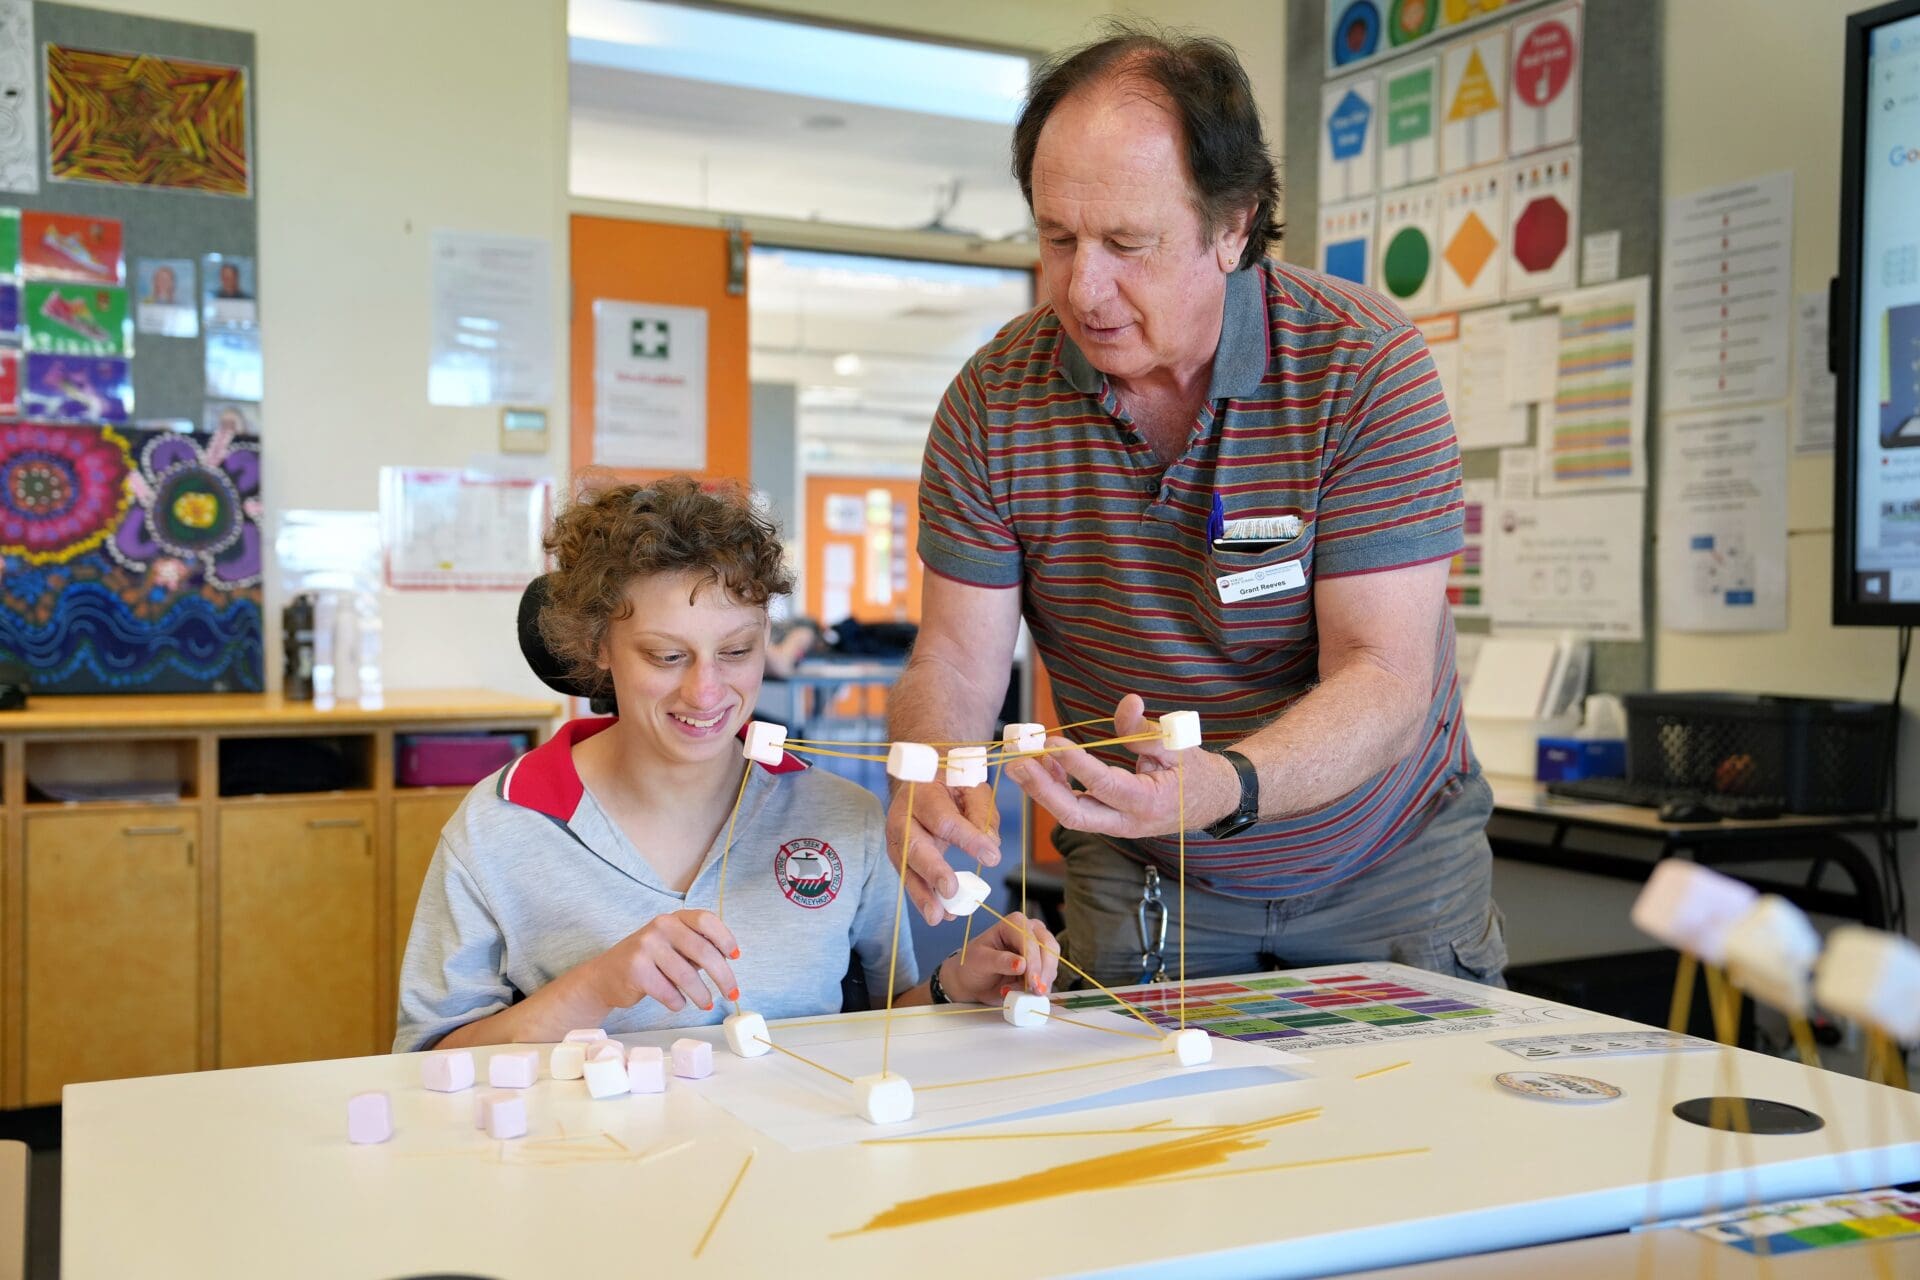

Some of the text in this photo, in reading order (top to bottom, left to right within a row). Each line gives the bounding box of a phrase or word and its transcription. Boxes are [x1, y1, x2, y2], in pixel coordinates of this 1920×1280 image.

[1888, 145, 1920, 168] Go
[1240, 586, 1260, 595] Grant
[1260, 580, 1286, 591] Reeves
[803, 840, 820, 848] SEEK
